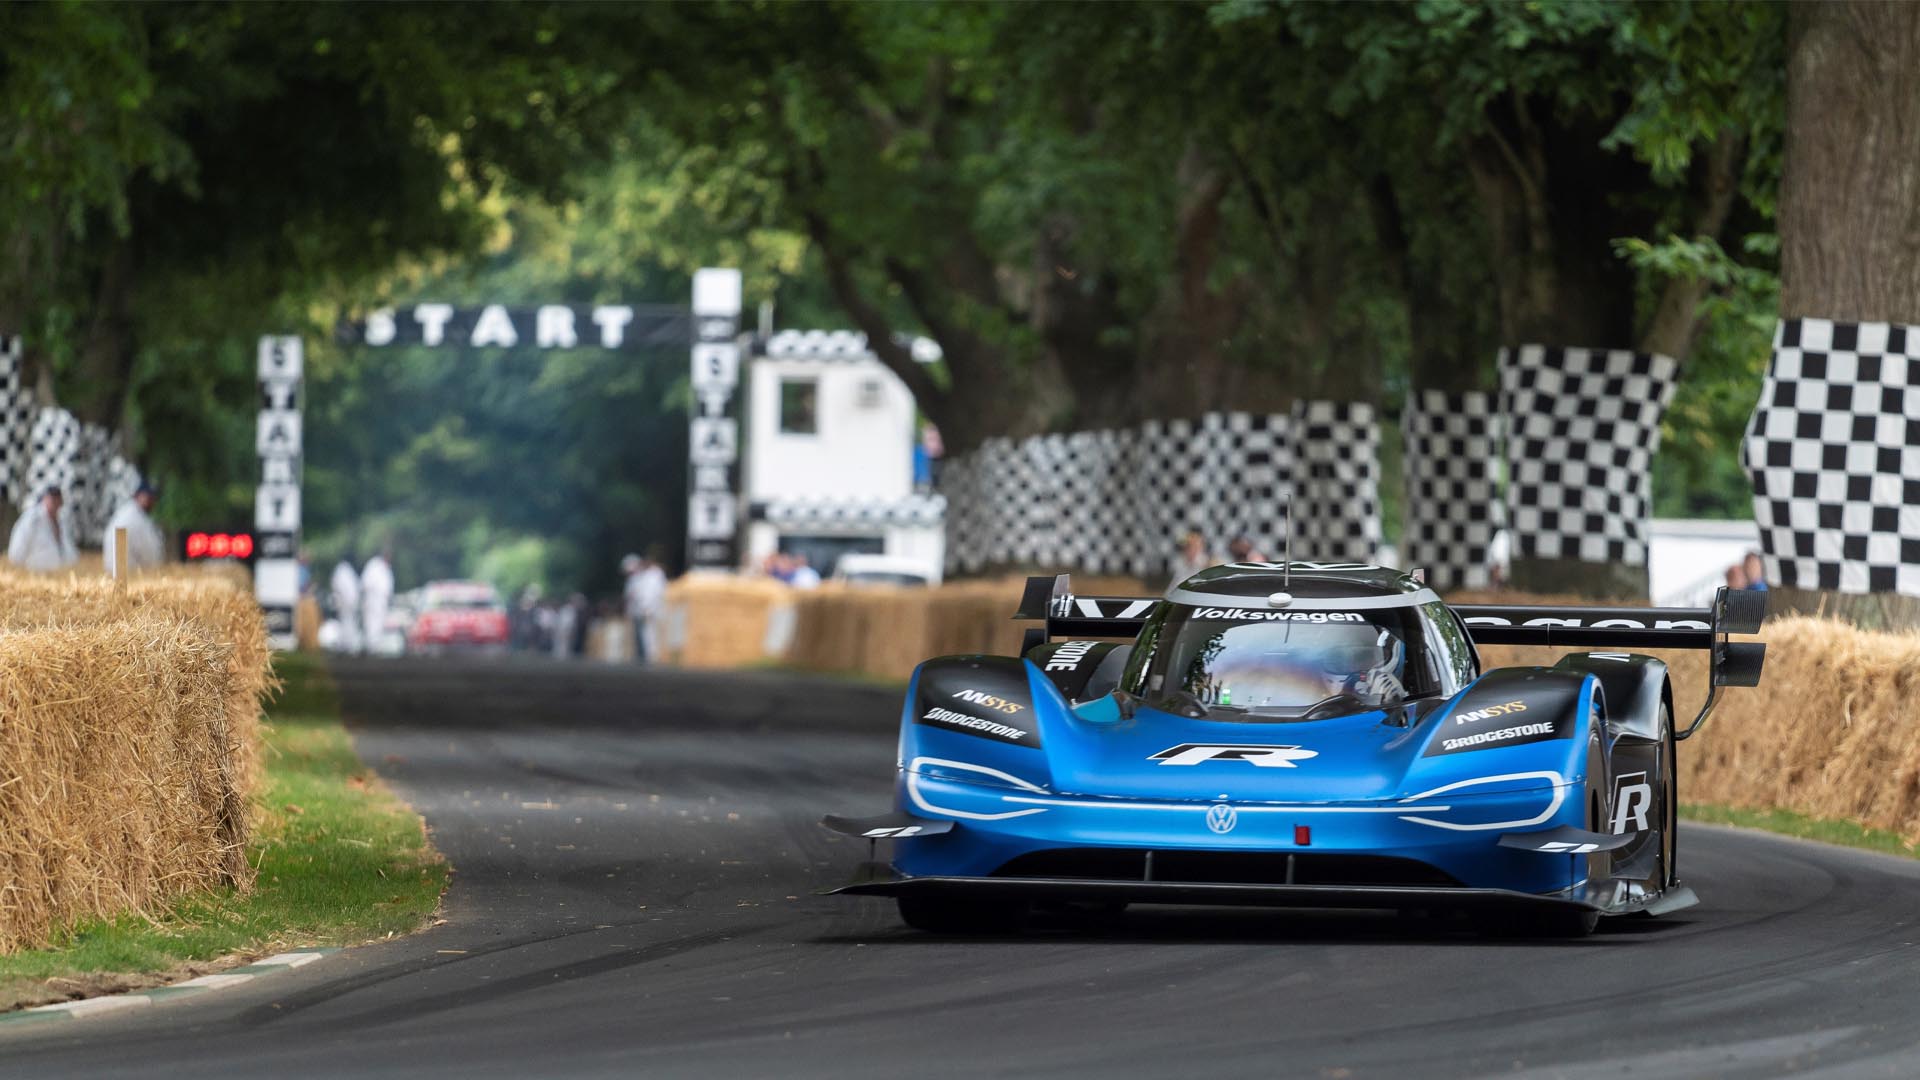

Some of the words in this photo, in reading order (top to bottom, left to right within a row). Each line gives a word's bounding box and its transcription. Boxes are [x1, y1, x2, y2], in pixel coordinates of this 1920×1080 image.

[364, 303, 634, 348] START
[1191, 608, 1365, 623] Volkswagen
[952, 689, 1024, 713] ANSYS
[1455, 701, 1527, 725] ANSYS
[923, 707, 1027, 739] BRIDGESTONE
[1442, 722, 1554, 750] BRIDGESTONE
[1146, 743, 1319, 768] R
[1609, 771, 1651, 835] R
